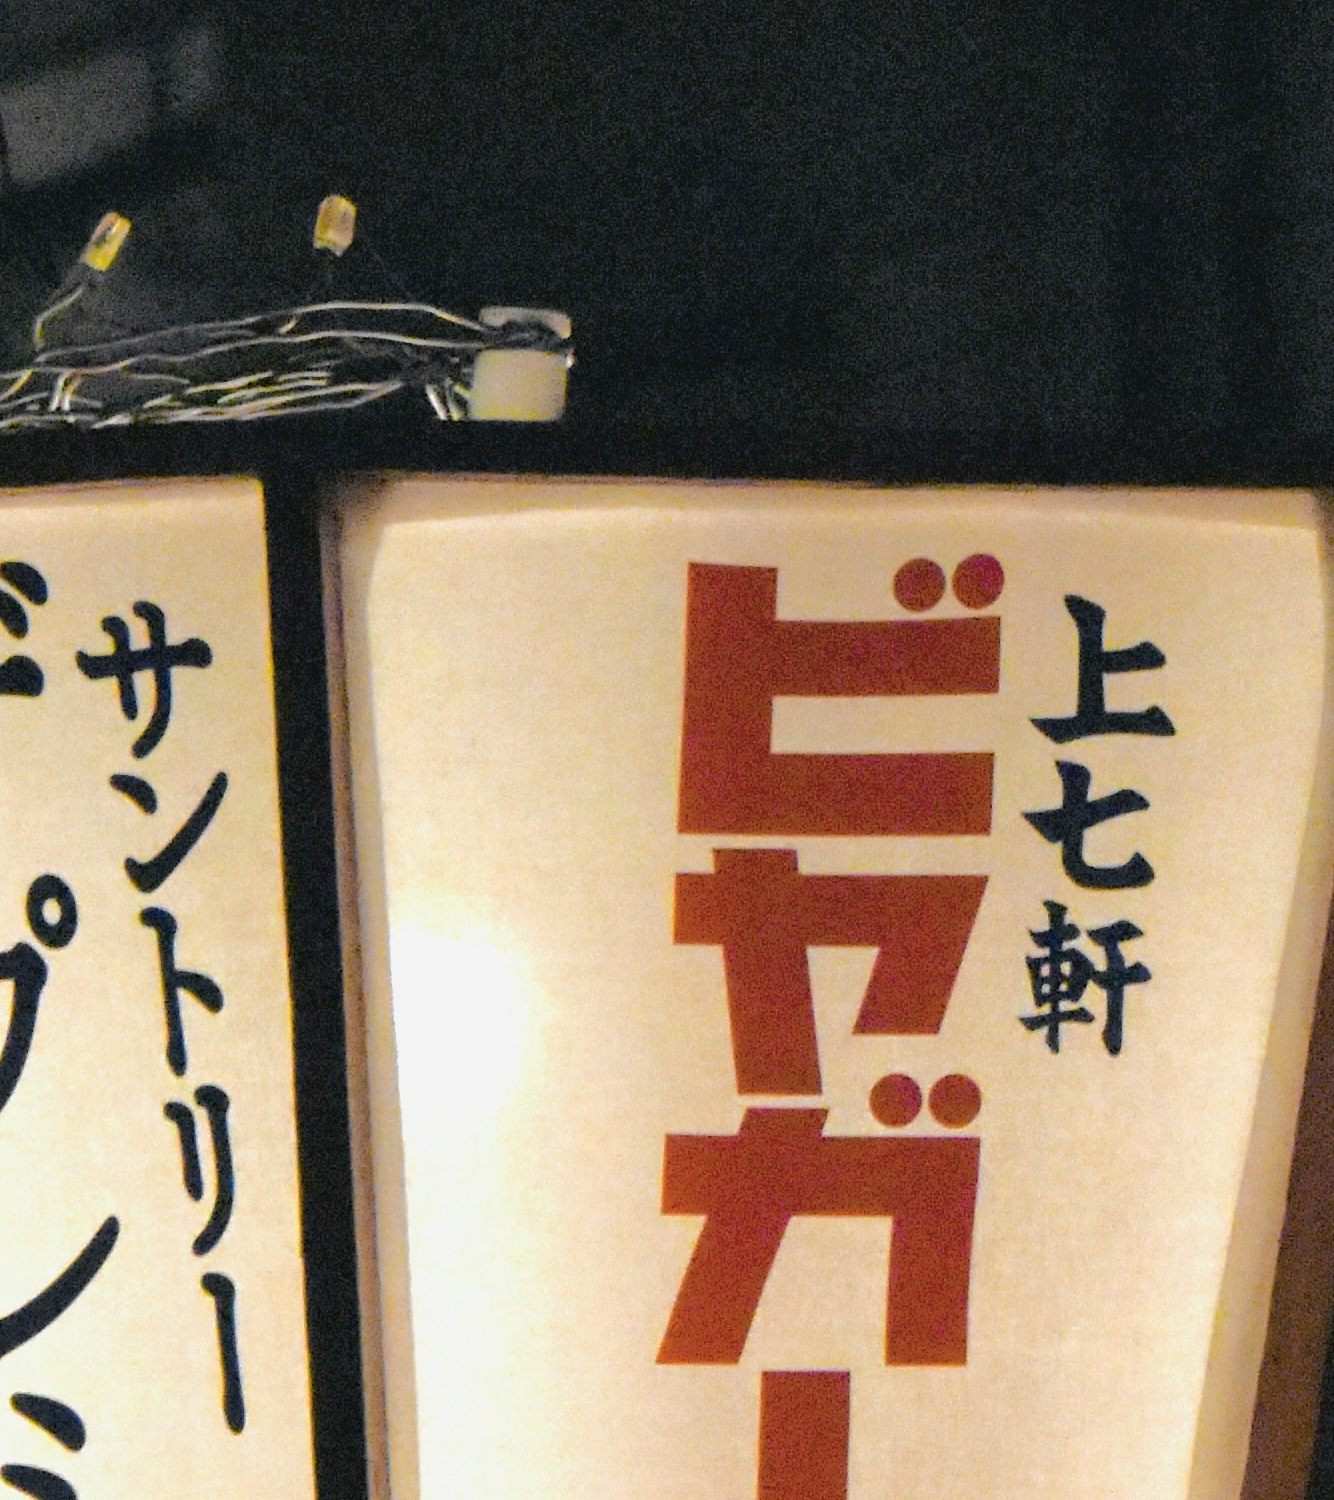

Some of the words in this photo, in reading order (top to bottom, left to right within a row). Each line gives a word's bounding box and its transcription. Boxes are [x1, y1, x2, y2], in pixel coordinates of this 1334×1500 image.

[75, 600, 247, 1436] サントリー
[1017, 594, 1177, 1057] 上七軒
